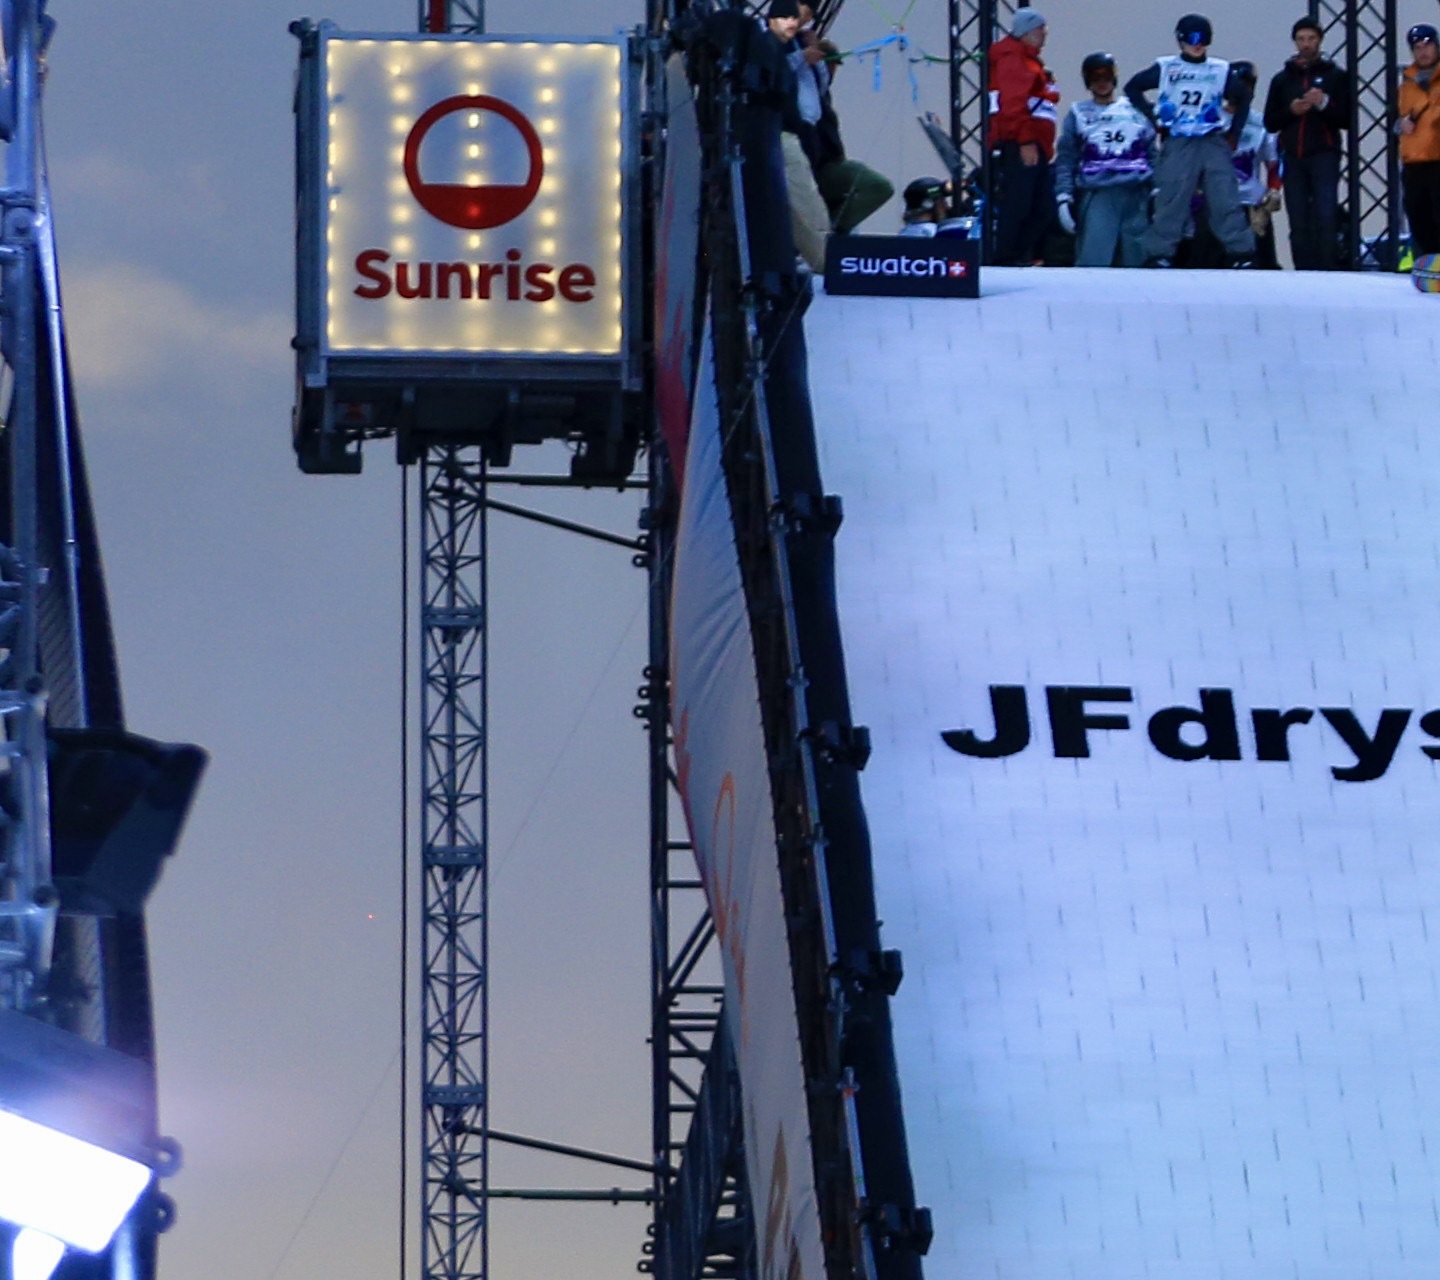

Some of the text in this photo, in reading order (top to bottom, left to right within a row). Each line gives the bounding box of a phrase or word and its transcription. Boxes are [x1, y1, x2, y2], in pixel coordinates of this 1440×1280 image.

[1181, 90, 1202, 106] 22
[1104, 130, 1125, 143] 36
[841, 256, 947, 276] swatch
[354, 248, 597, 303] Sunrise
